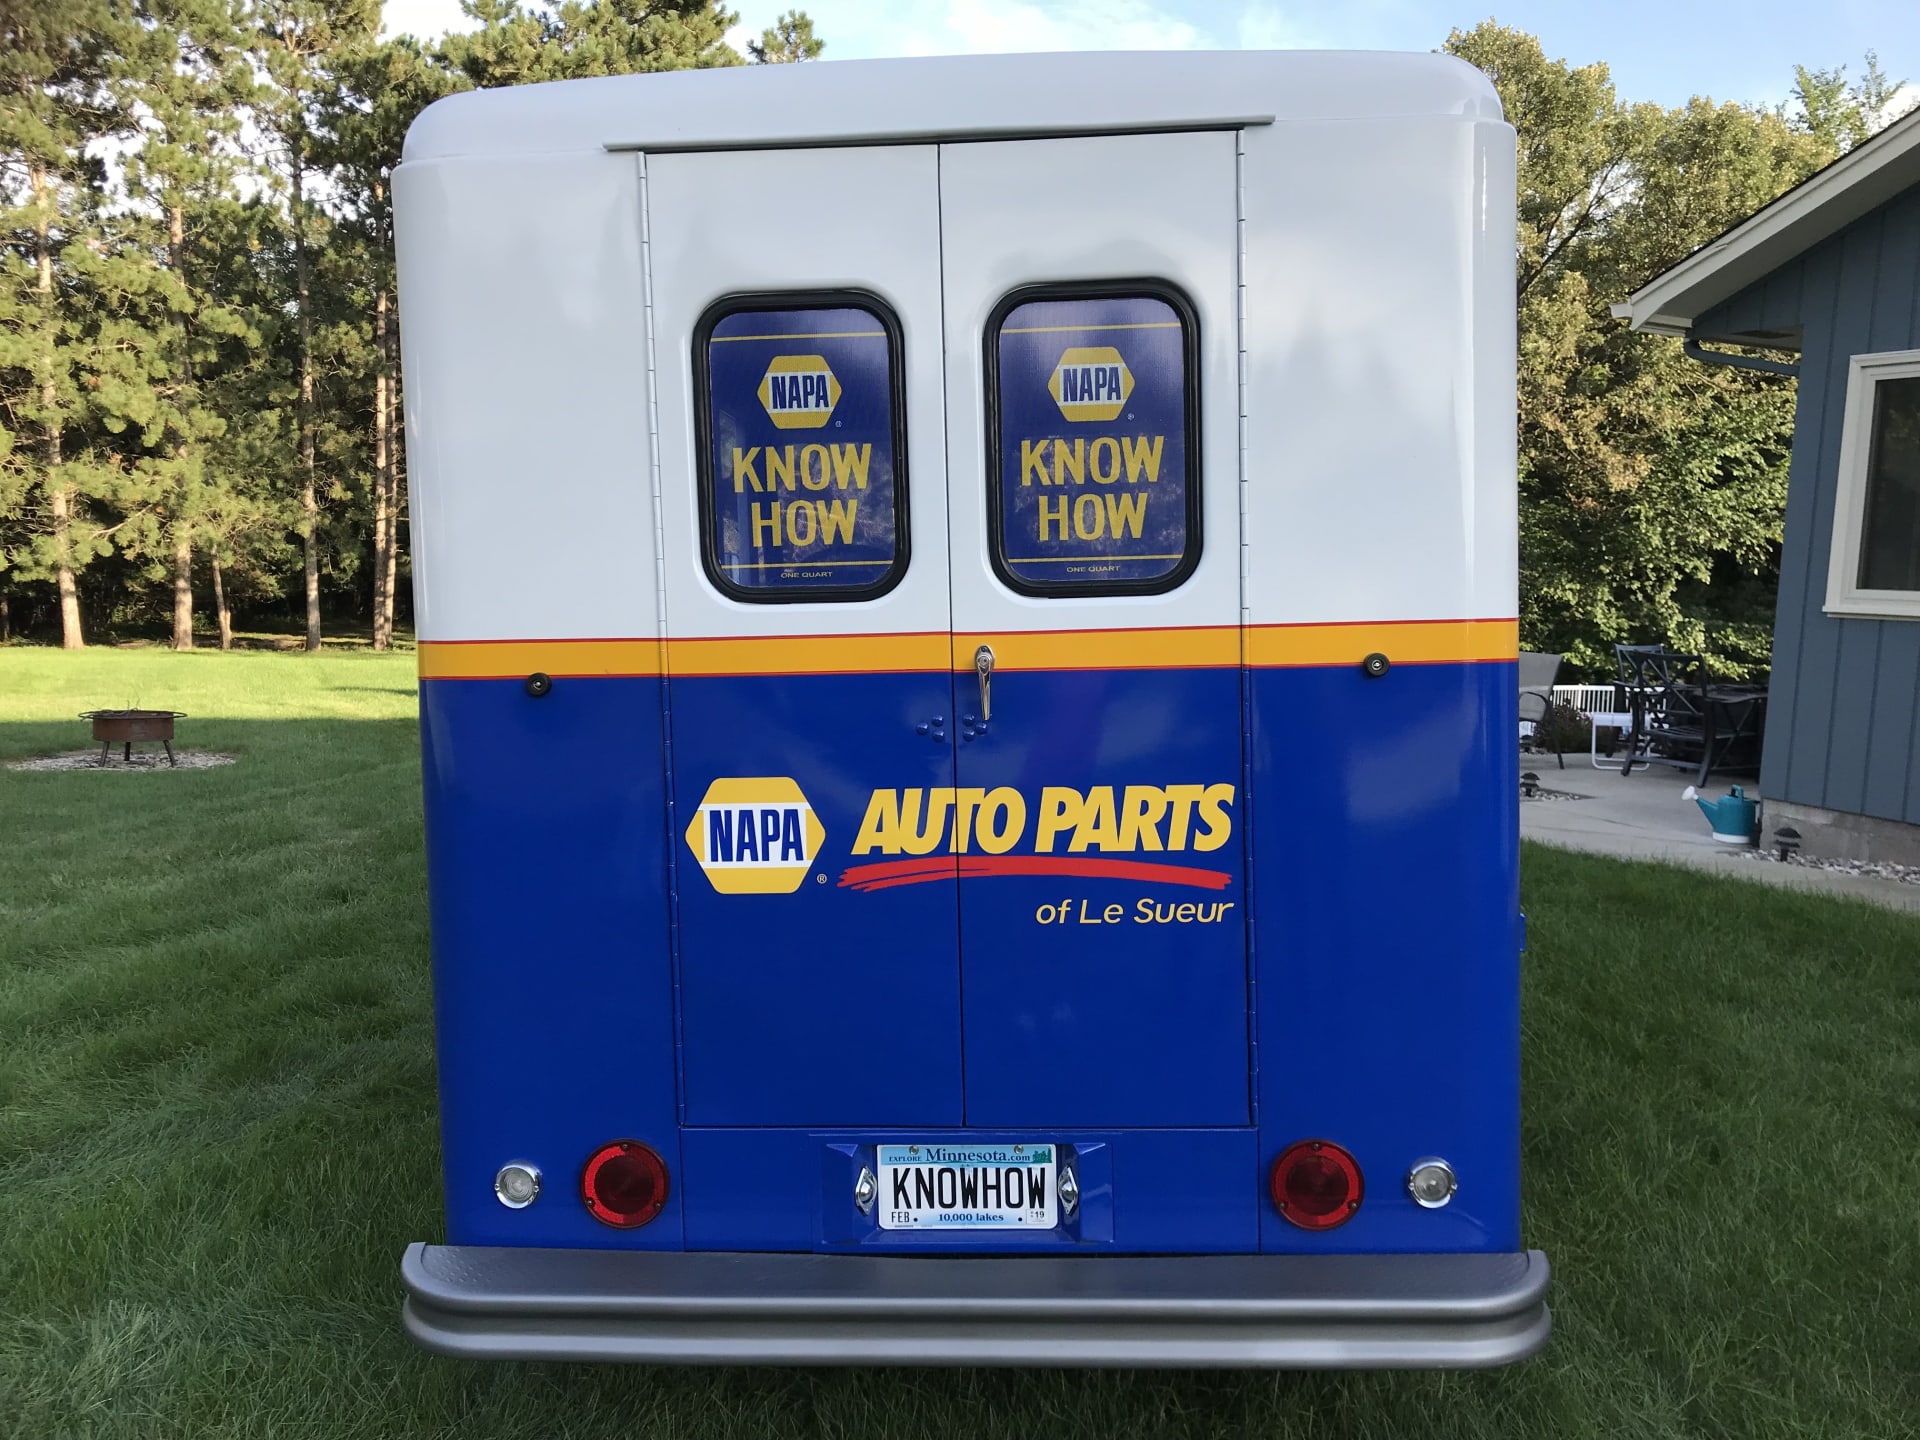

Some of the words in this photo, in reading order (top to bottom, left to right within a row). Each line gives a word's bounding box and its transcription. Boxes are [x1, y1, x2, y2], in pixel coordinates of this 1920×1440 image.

[771, 373, 830, 410] NAPA
[1063, 366, 1121, 402] NAPA
[732, 443, 872, 493] KNOW
[1020, 435, 1164, 487] KNOW
[751, 499, 857, 548] HOW
[1038, 492, 1148, 542] HOW
[1089, 565, 1121, 573] QUART
[709, 808, 803, 862] NAPA
[850, 786, 1027, 855] AUTO
[1034, 783, 1236, 853] PARTS
[1036, 899, 1073, 924] of
[1079, 899, 1124, 923] Le
[1133, 898, 1235, 924] Sueur
[893, 1167, 1046, 1209] KNOWHOW
[891, 1211, 910, 1223] FEB
[938, 1212, 973, 1223] 10,000
[975, 1211, 1004, 1222] lakes
